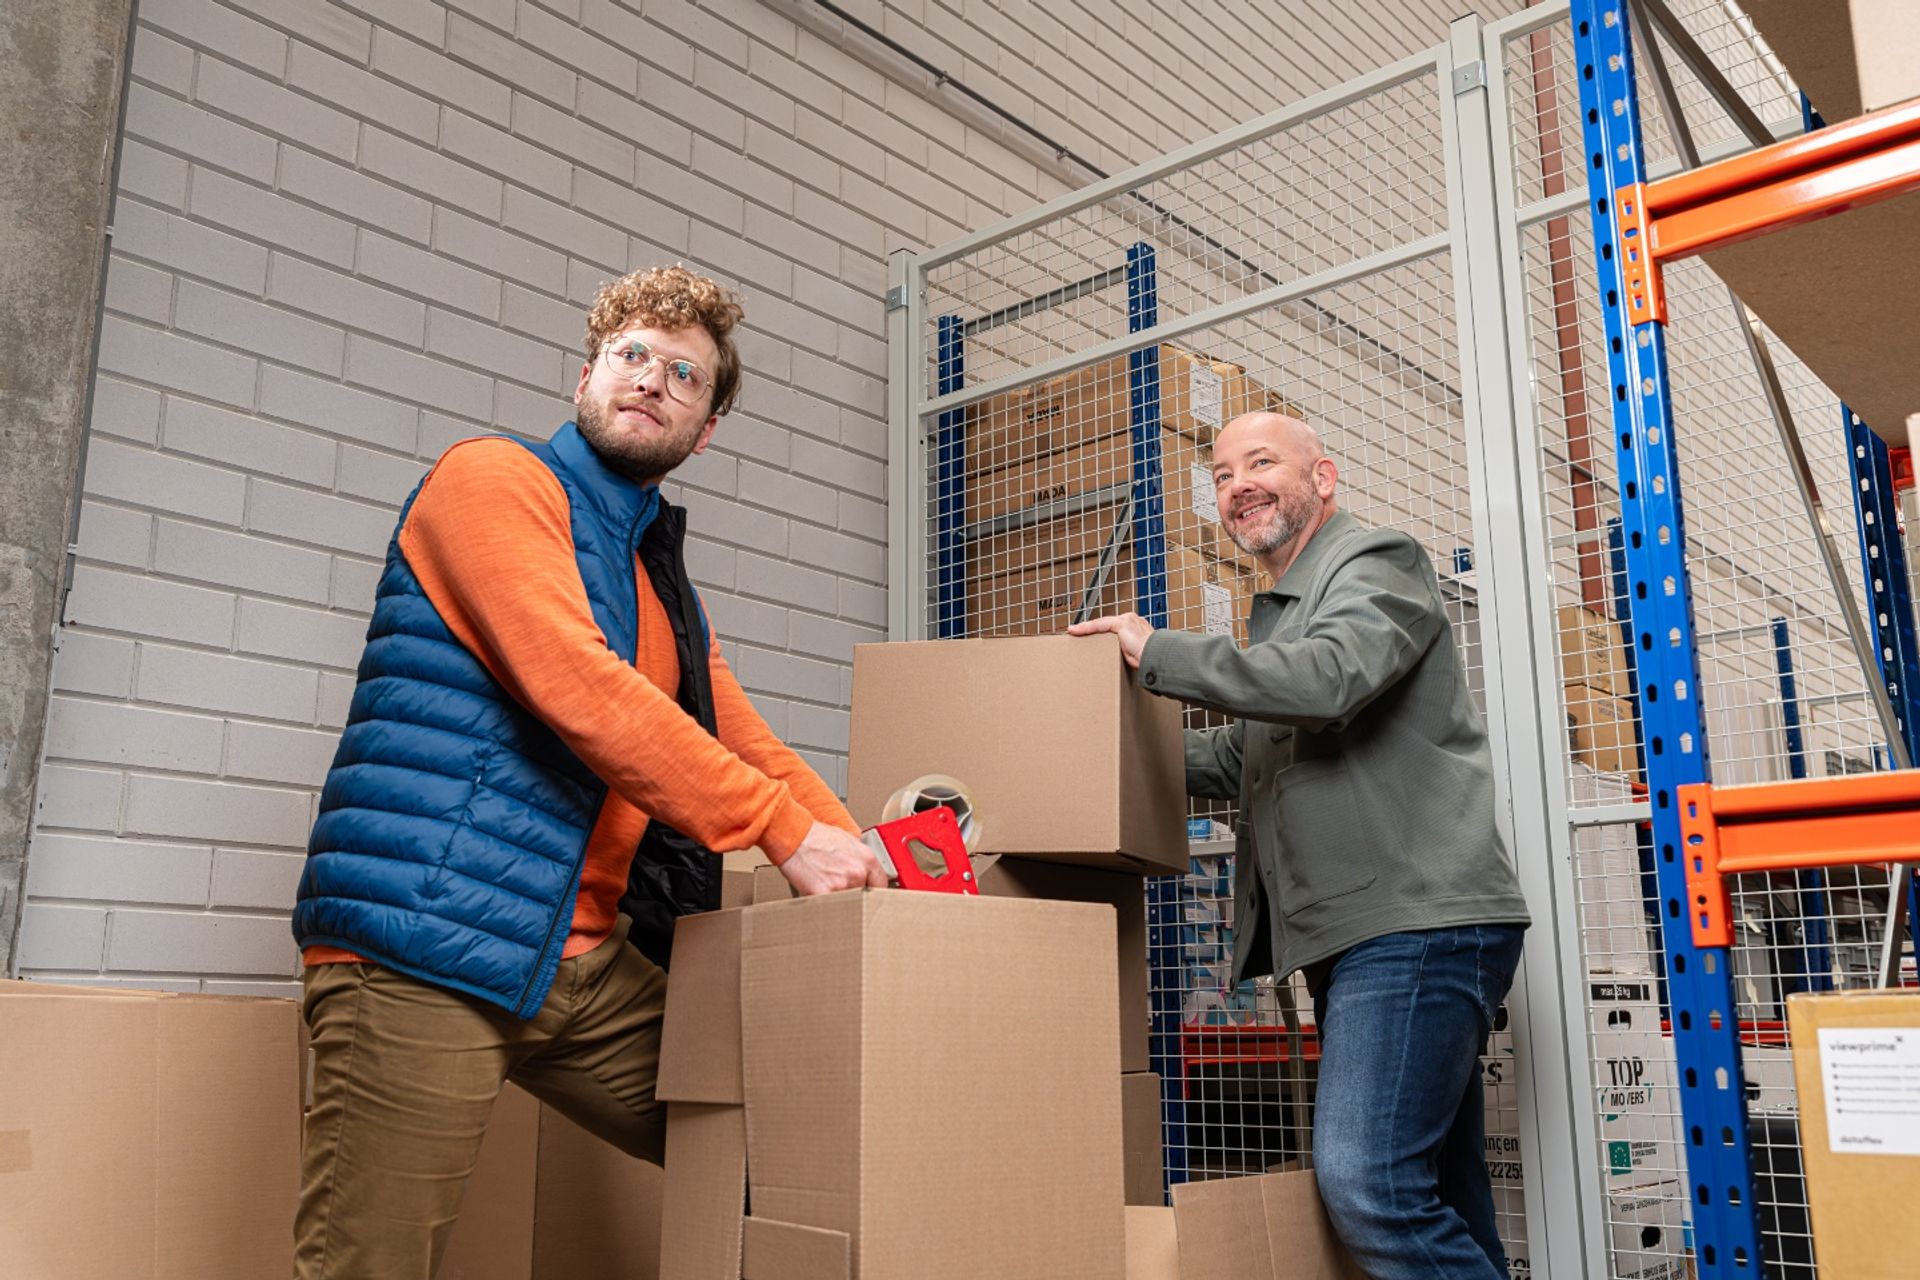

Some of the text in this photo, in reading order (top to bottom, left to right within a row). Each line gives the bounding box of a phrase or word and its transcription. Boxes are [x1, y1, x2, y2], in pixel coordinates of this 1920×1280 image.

[1033, 485, 1066, 504] MADA
[1607, 1056, 1644, 1090] TOP
[1611, 1091, 1644, 1106] MOVERS
